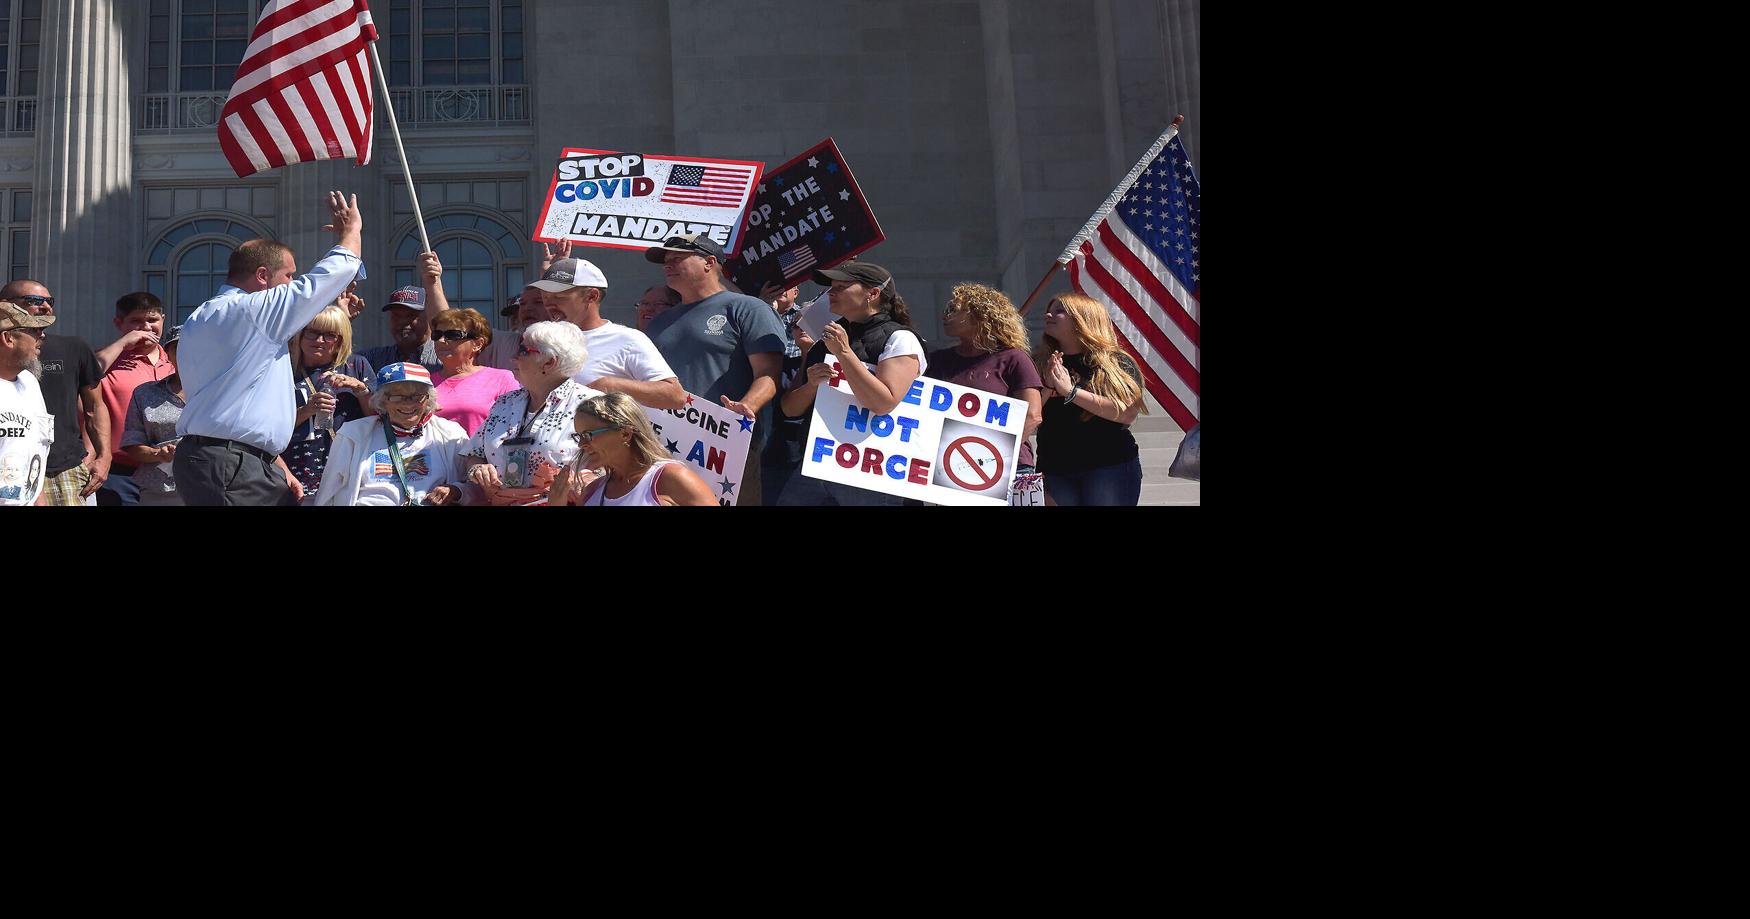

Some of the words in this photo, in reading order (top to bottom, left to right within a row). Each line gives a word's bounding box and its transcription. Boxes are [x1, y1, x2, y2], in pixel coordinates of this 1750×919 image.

[559, 155, 642, 180] STOP
[555, 177, 654, 203] COVID
[746, 204, 772, 229] OP
[782, 176, 820, 207] THE
[572, 213, 731, 246] MANDATE
[742, 205, 835, 265] MANDATE
[829, 362, 1010, 427] FEDOM
[0, 428, 25, 437] DEEZ
[845, 404, 919, 443] NOT
[686, 440, 727, 475] AN
[812, 436, 931, 486] FORCE
